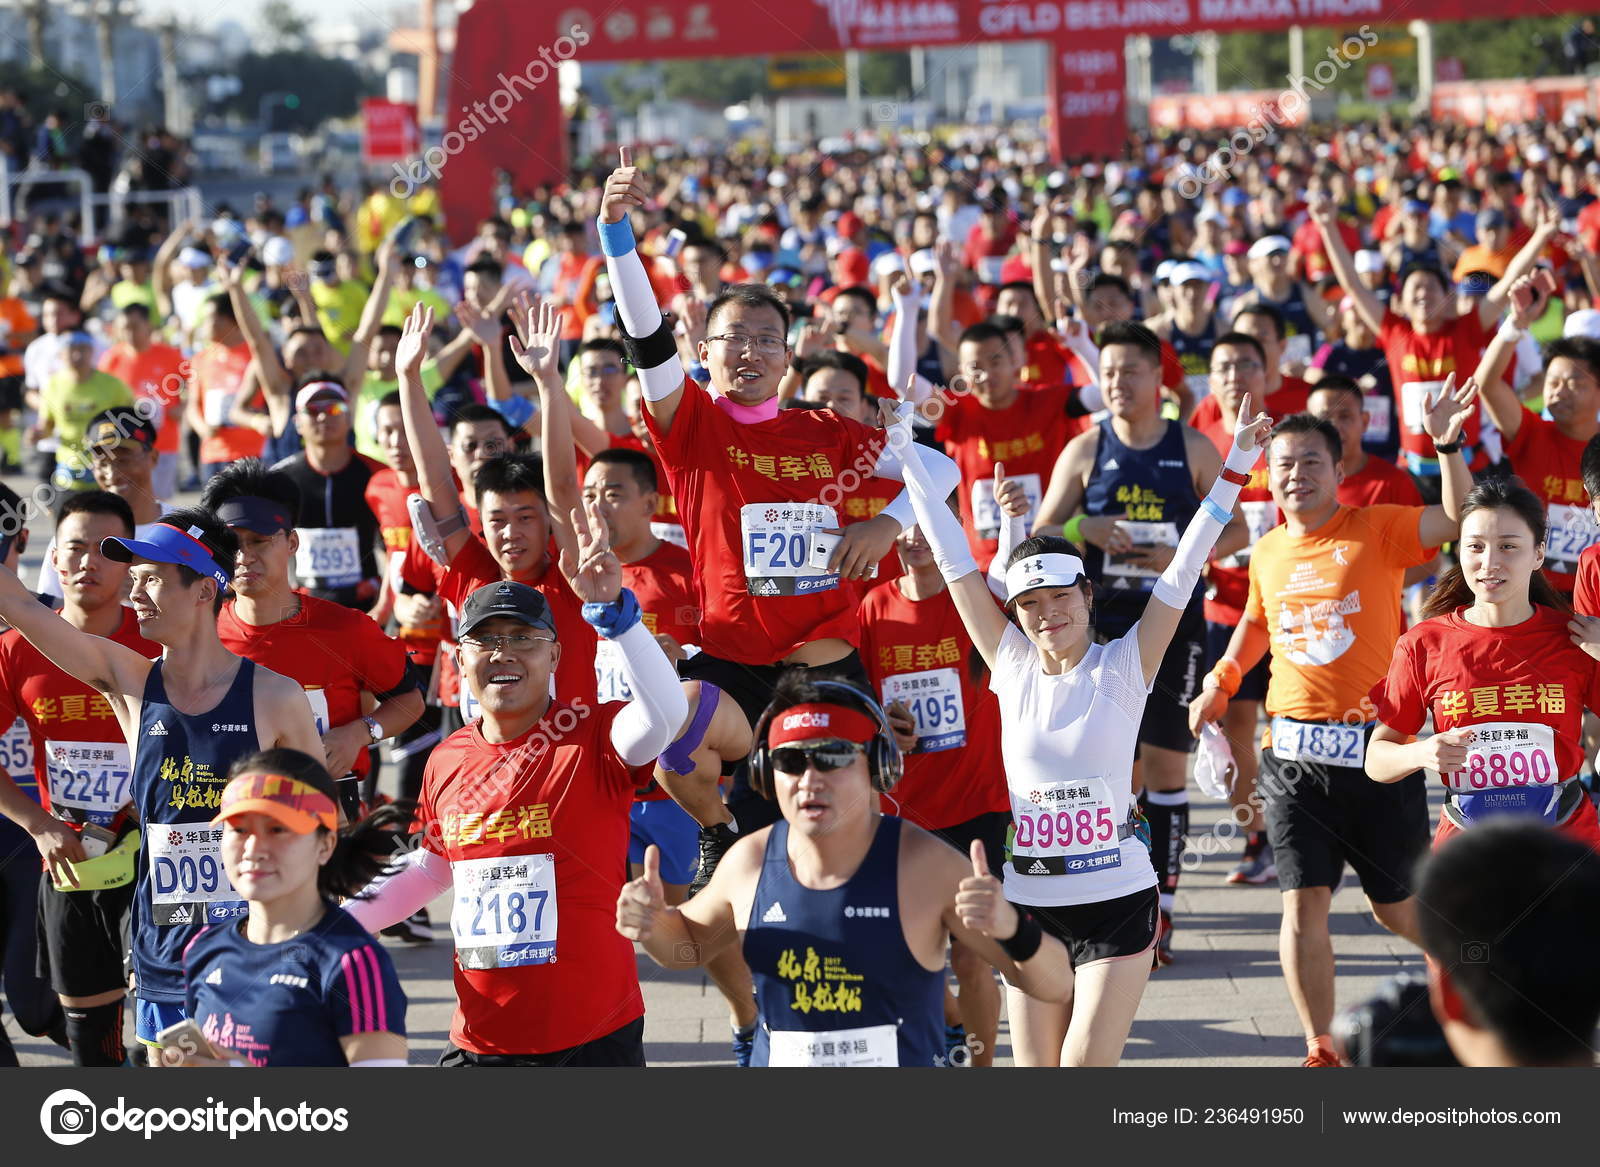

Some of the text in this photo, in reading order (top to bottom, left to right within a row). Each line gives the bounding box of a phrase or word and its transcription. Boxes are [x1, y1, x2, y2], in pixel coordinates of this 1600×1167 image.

[1065, 0, 1190, 30] BEIJING
[726, 445, 834, 481] 华夏幸福
[782, 510, 823, 523] 华夏幸福
[749, 532, 805, 568] F20
[880, 637, 960, 671] 华夏幸福
[32, 695, 115, 724] 华夏幸
[886, 693, 958, 729] 195
[1440, 683, 1566, 721] 华夏幸福
[1480, 729, 1528, 742] 华夏幸福
[70, 749, 114, 760] 华夏幸福
[1044, 787, 1091, 801] 华夏幸福
[185, 829, 223, 844] 华夏幸
[1017, 807, 1113, 848] D9985
[154, 855, 236, 894] D09
[790, 981, 862, 1014] 马拉松
[807, 1039, 868, 1058] 华夏幸福
